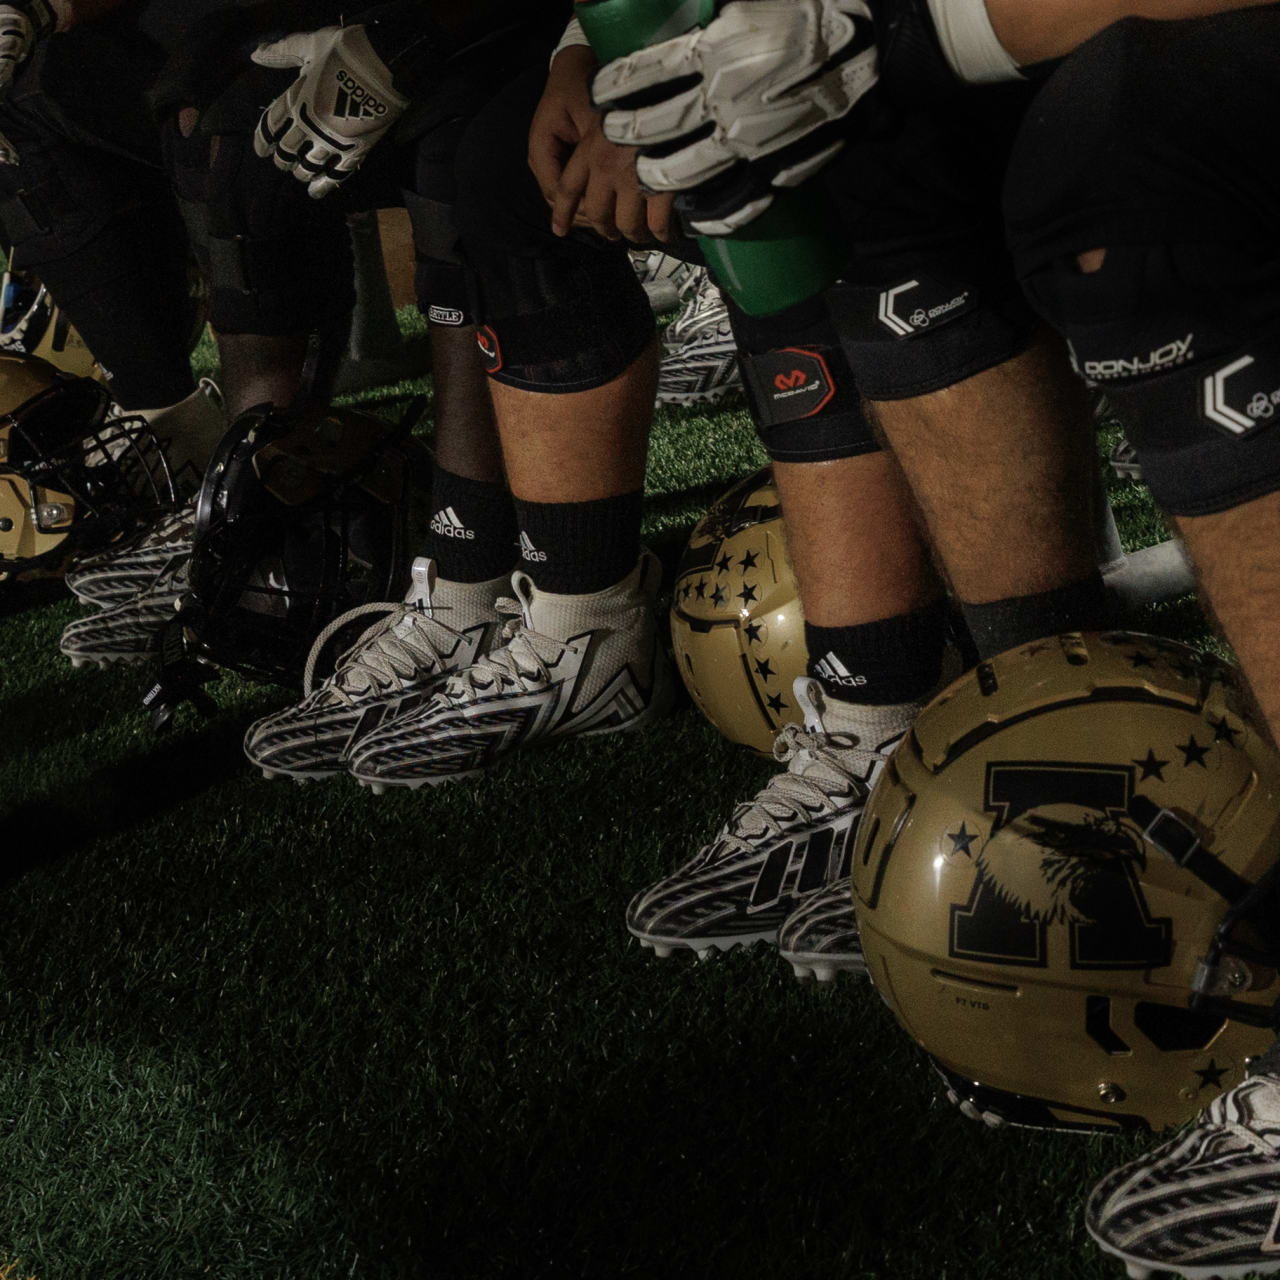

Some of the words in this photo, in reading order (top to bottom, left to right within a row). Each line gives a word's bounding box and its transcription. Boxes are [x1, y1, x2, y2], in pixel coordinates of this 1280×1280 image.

[336, 69, 388, 115] adidas
[1084, 333, 1194, 376] DONJOY
[430, 519, 476, 540] adidas
